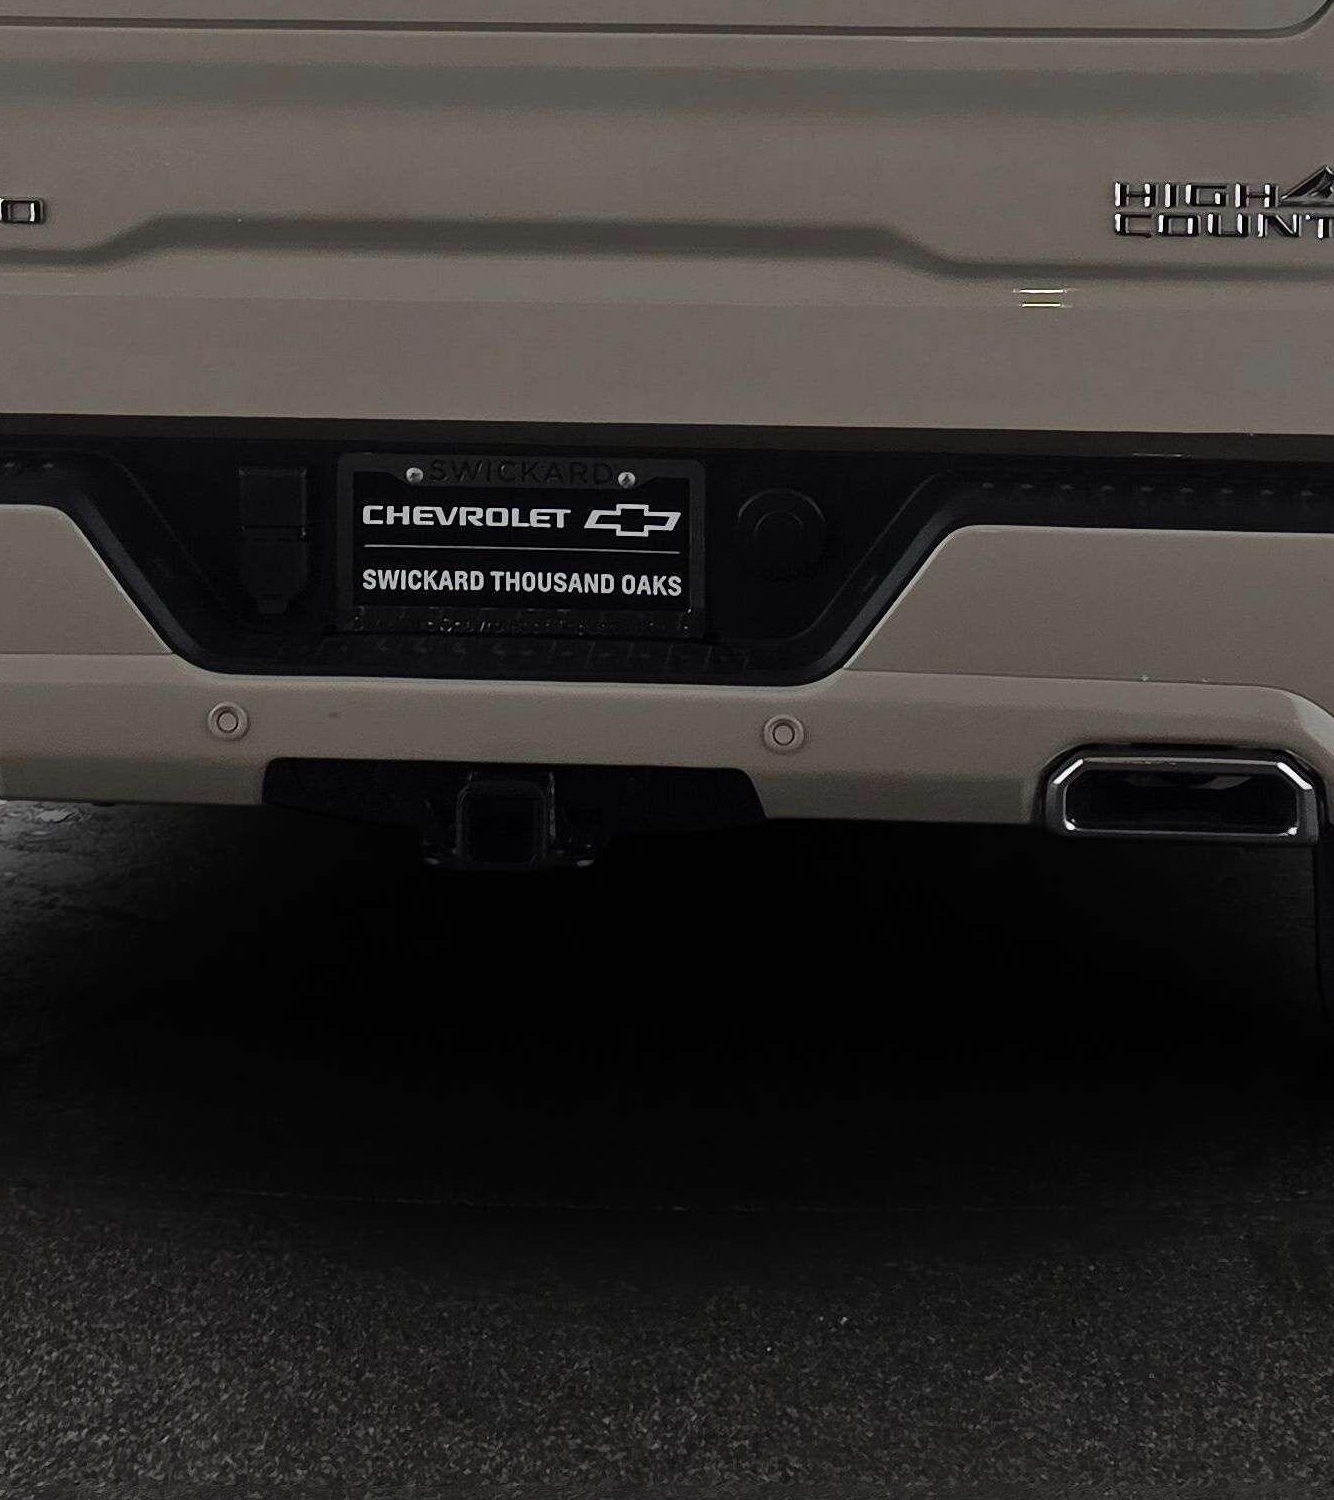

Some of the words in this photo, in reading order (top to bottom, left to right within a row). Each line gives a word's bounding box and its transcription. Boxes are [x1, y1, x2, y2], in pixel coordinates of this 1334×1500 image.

[1113, 182, 1281, 208] HIGH
[429, 459, 615, 486] SWICKARD
[362, 505, 572, 529] CHEVROLET
[362, 569, 485, 592] SWICKARD
[489, 571, 615, 595] THOUSAND
[621, 574, 682, 597] OAKS
